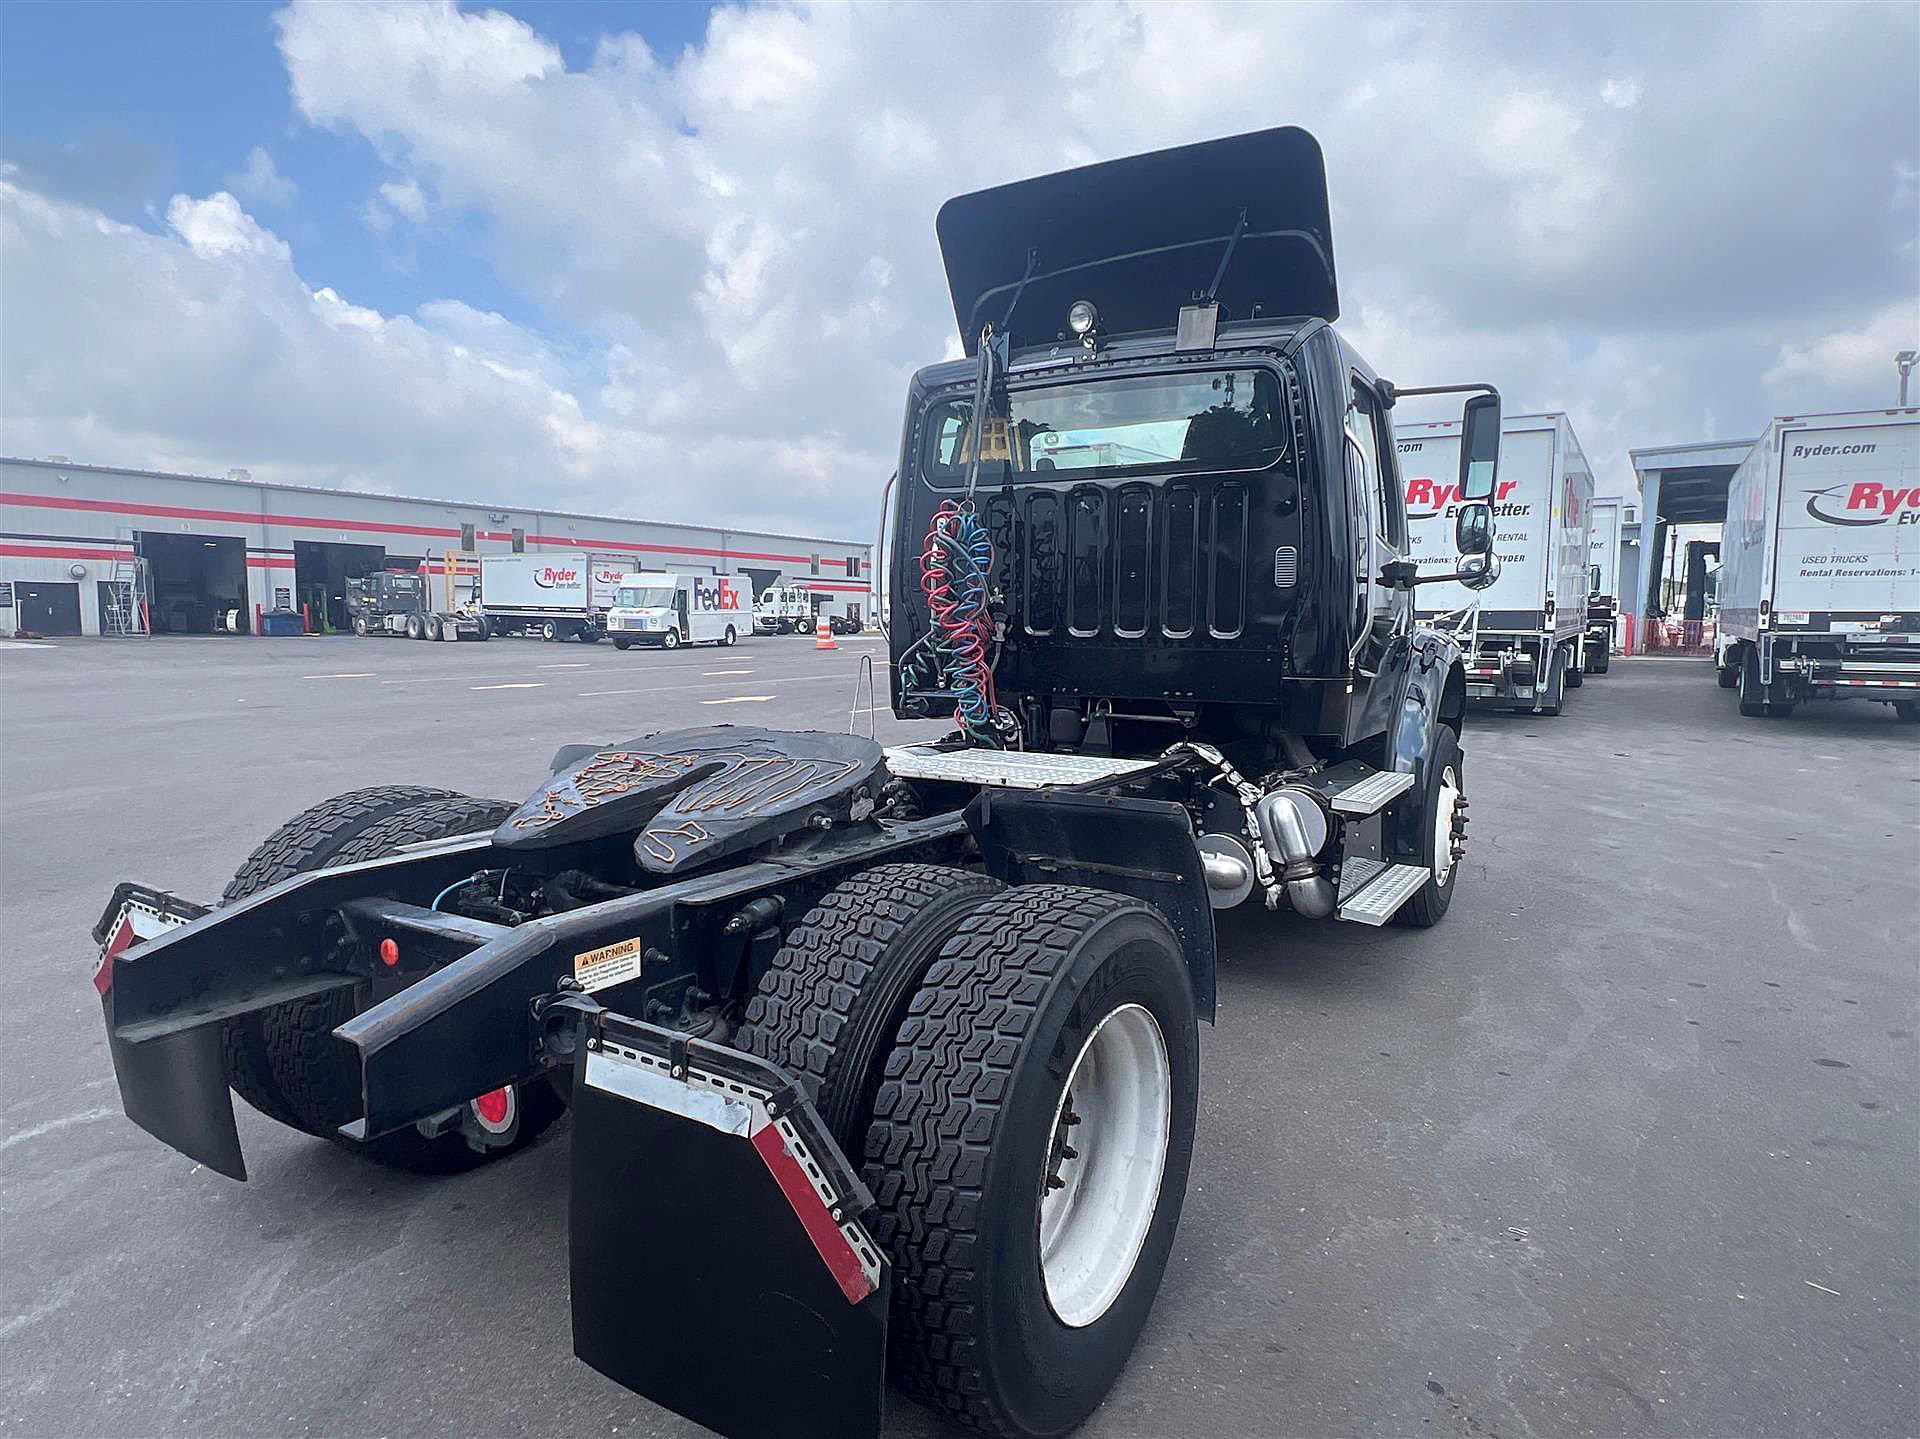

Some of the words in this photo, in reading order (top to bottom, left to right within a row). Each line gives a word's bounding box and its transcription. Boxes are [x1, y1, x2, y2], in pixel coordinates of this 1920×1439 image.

[1397, 443, 1422, 453] com
[1792, 443, 1876, 459] Ryder.com
[1405, 478, 1517, 509] Ryr
[1494, 503, 1530, 517] etter.
[1496, 533, 1528, 542] RENTAL
[1801, 556, 1827, 564] USED
[1830, 555, 1869, 563] TRUCKS
[544, 568, 576, 584] Ryder
[1800, 569, 1832, 577] Rental
[1835, 568, 1906, 577] Reservations:
[694, 576, 740, 611] FedEx
[590, 943, 634, 963] WARNING
